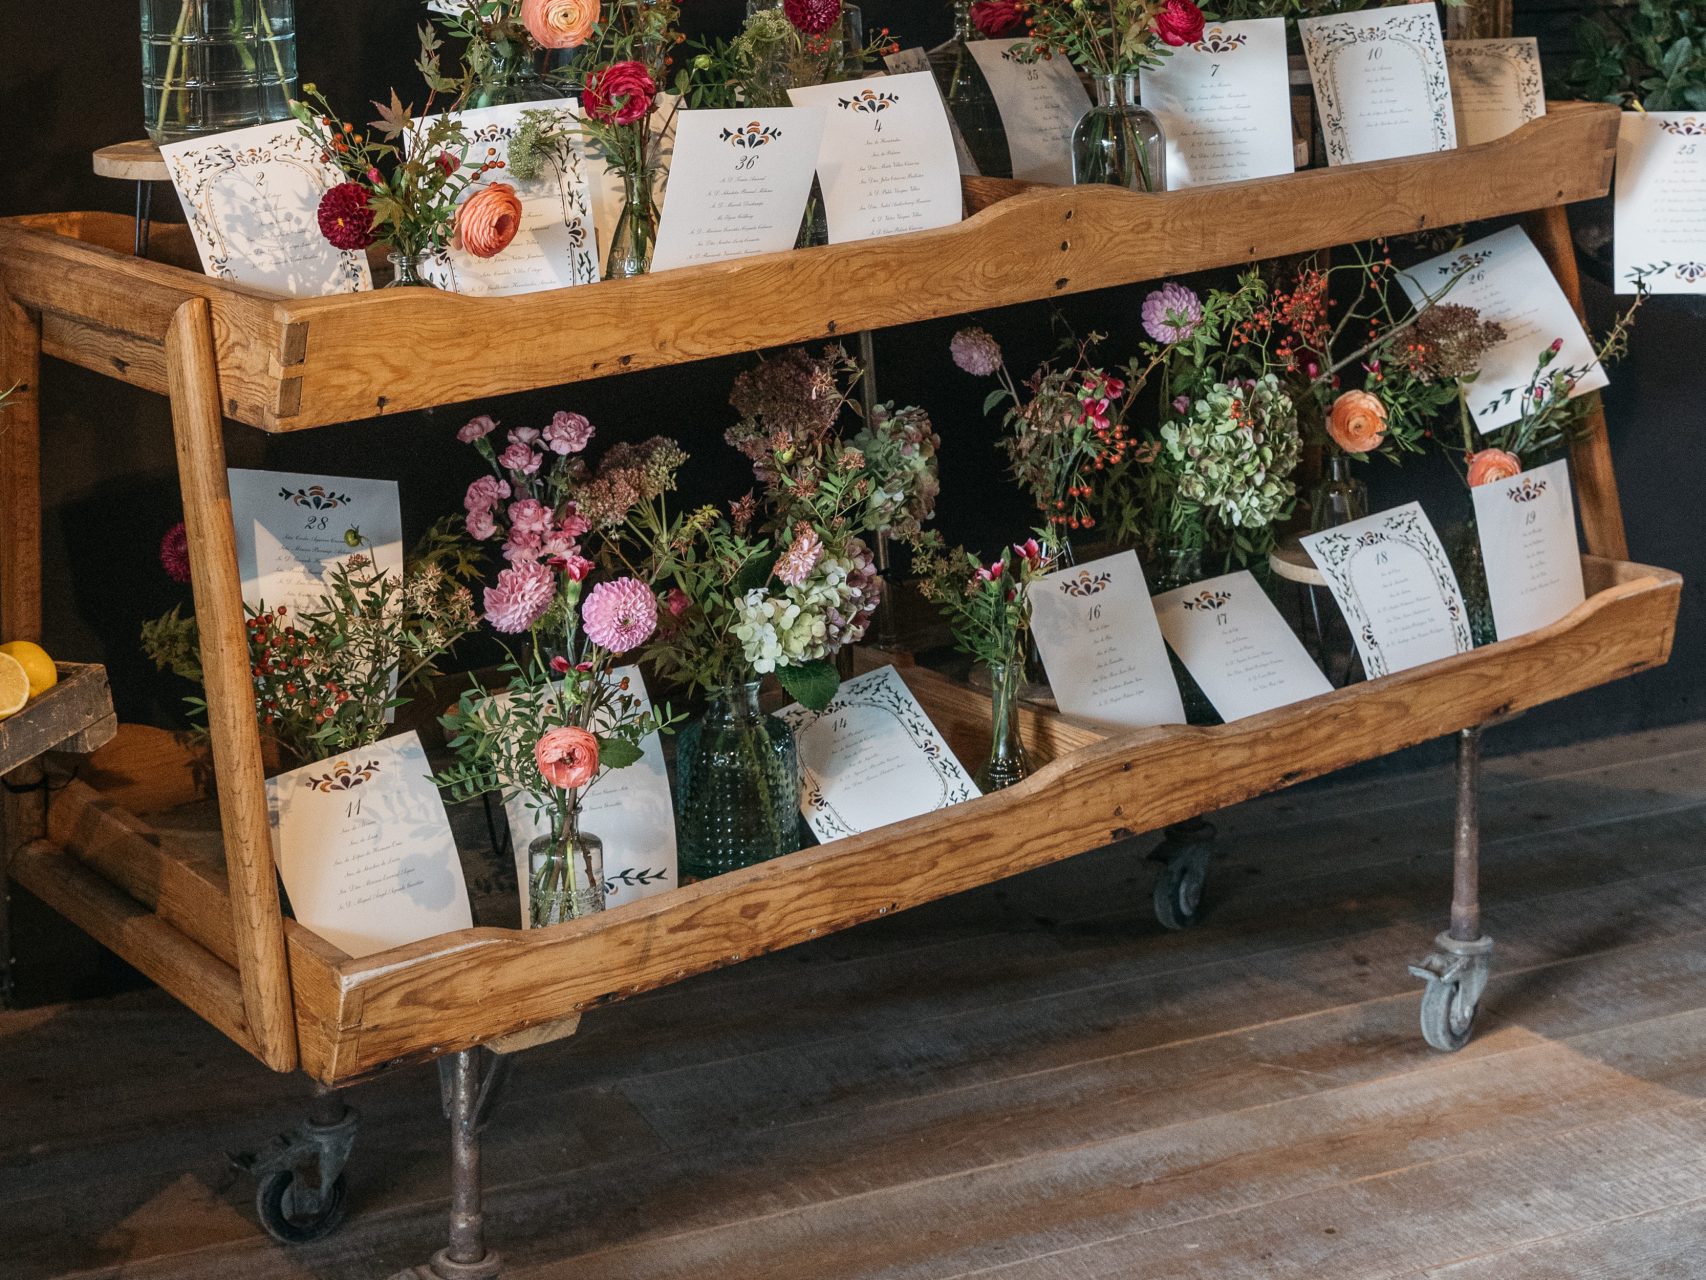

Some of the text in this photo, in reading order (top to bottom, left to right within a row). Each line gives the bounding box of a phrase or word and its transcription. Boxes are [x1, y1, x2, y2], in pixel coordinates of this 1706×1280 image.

[1367, 47, 1383, 61] 10
[1211, 64, 1220, 77] 7
[874, 119, 883, 133] 4
[1677, 143, 1697, 156] 25
[735, 155, 760, 170] 36
[255, 172, 265, 187] 2
[1468, 270, 1486, 285] 26
[304, 515, 329, 531] 28
[1525, 510, 1536, 526] 19
[1375, 551, 1388, 566] 18
[1088, 604, 1102, 621] 16
[1216, 613, 1227, 626] 17
[831, 718, 847, 732] 14
[345, 799, 361, 818] 11
